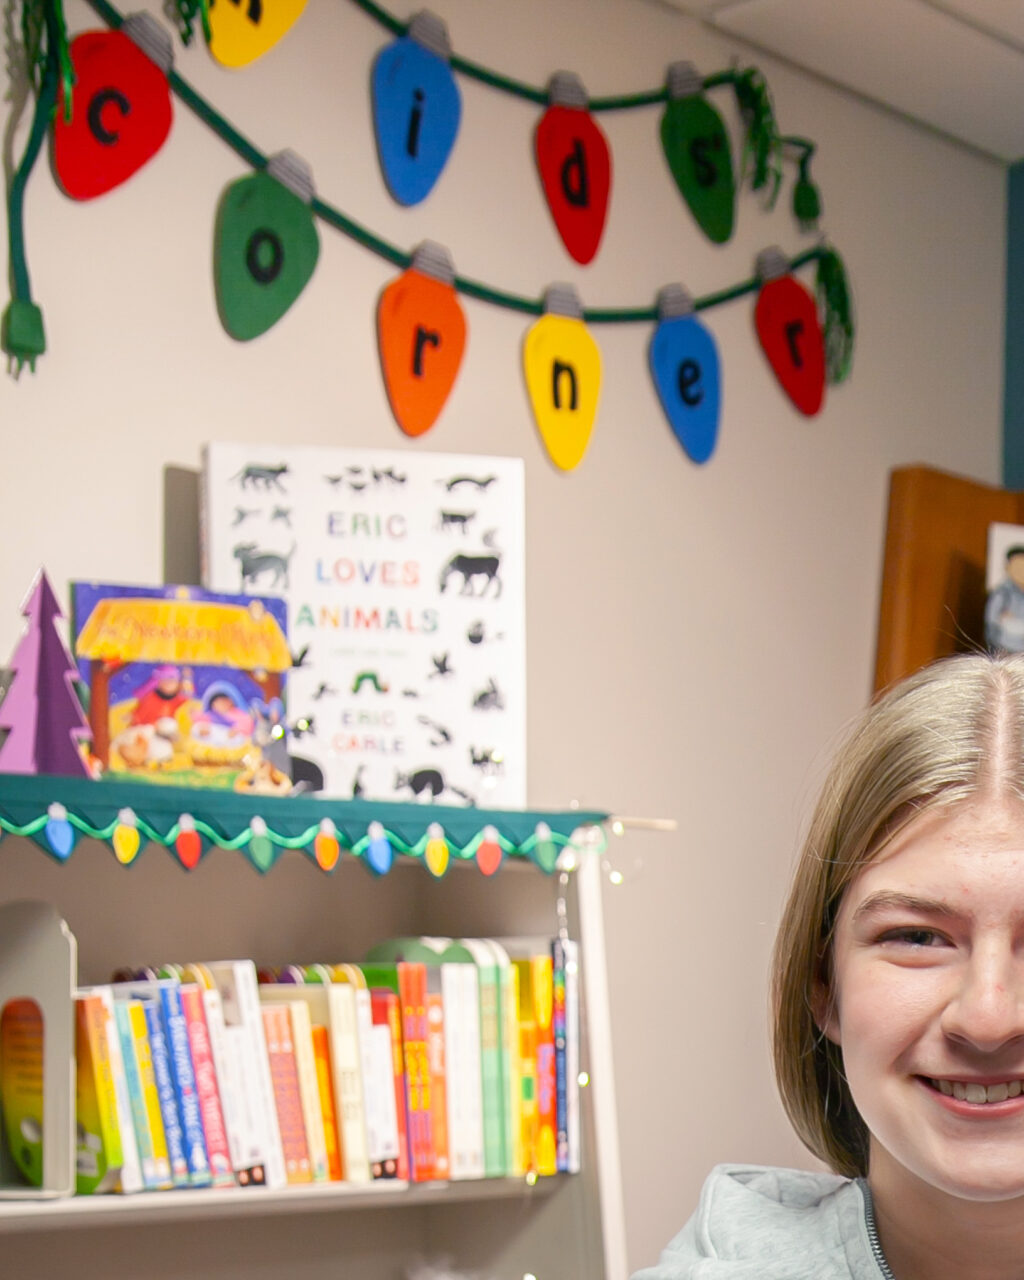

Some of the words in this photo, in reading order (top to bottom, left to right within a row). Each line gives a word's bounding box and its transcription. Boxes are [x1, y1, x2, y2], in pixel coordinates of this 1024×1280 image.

[328, 511, 407, 538] ERIC
[316, 557, 420, 587] LOVES
[296, 603, 439, 633] ANIMALS
[341, 709, 395, 728] ERIC
[332, 735, 405, 752] CARLE
